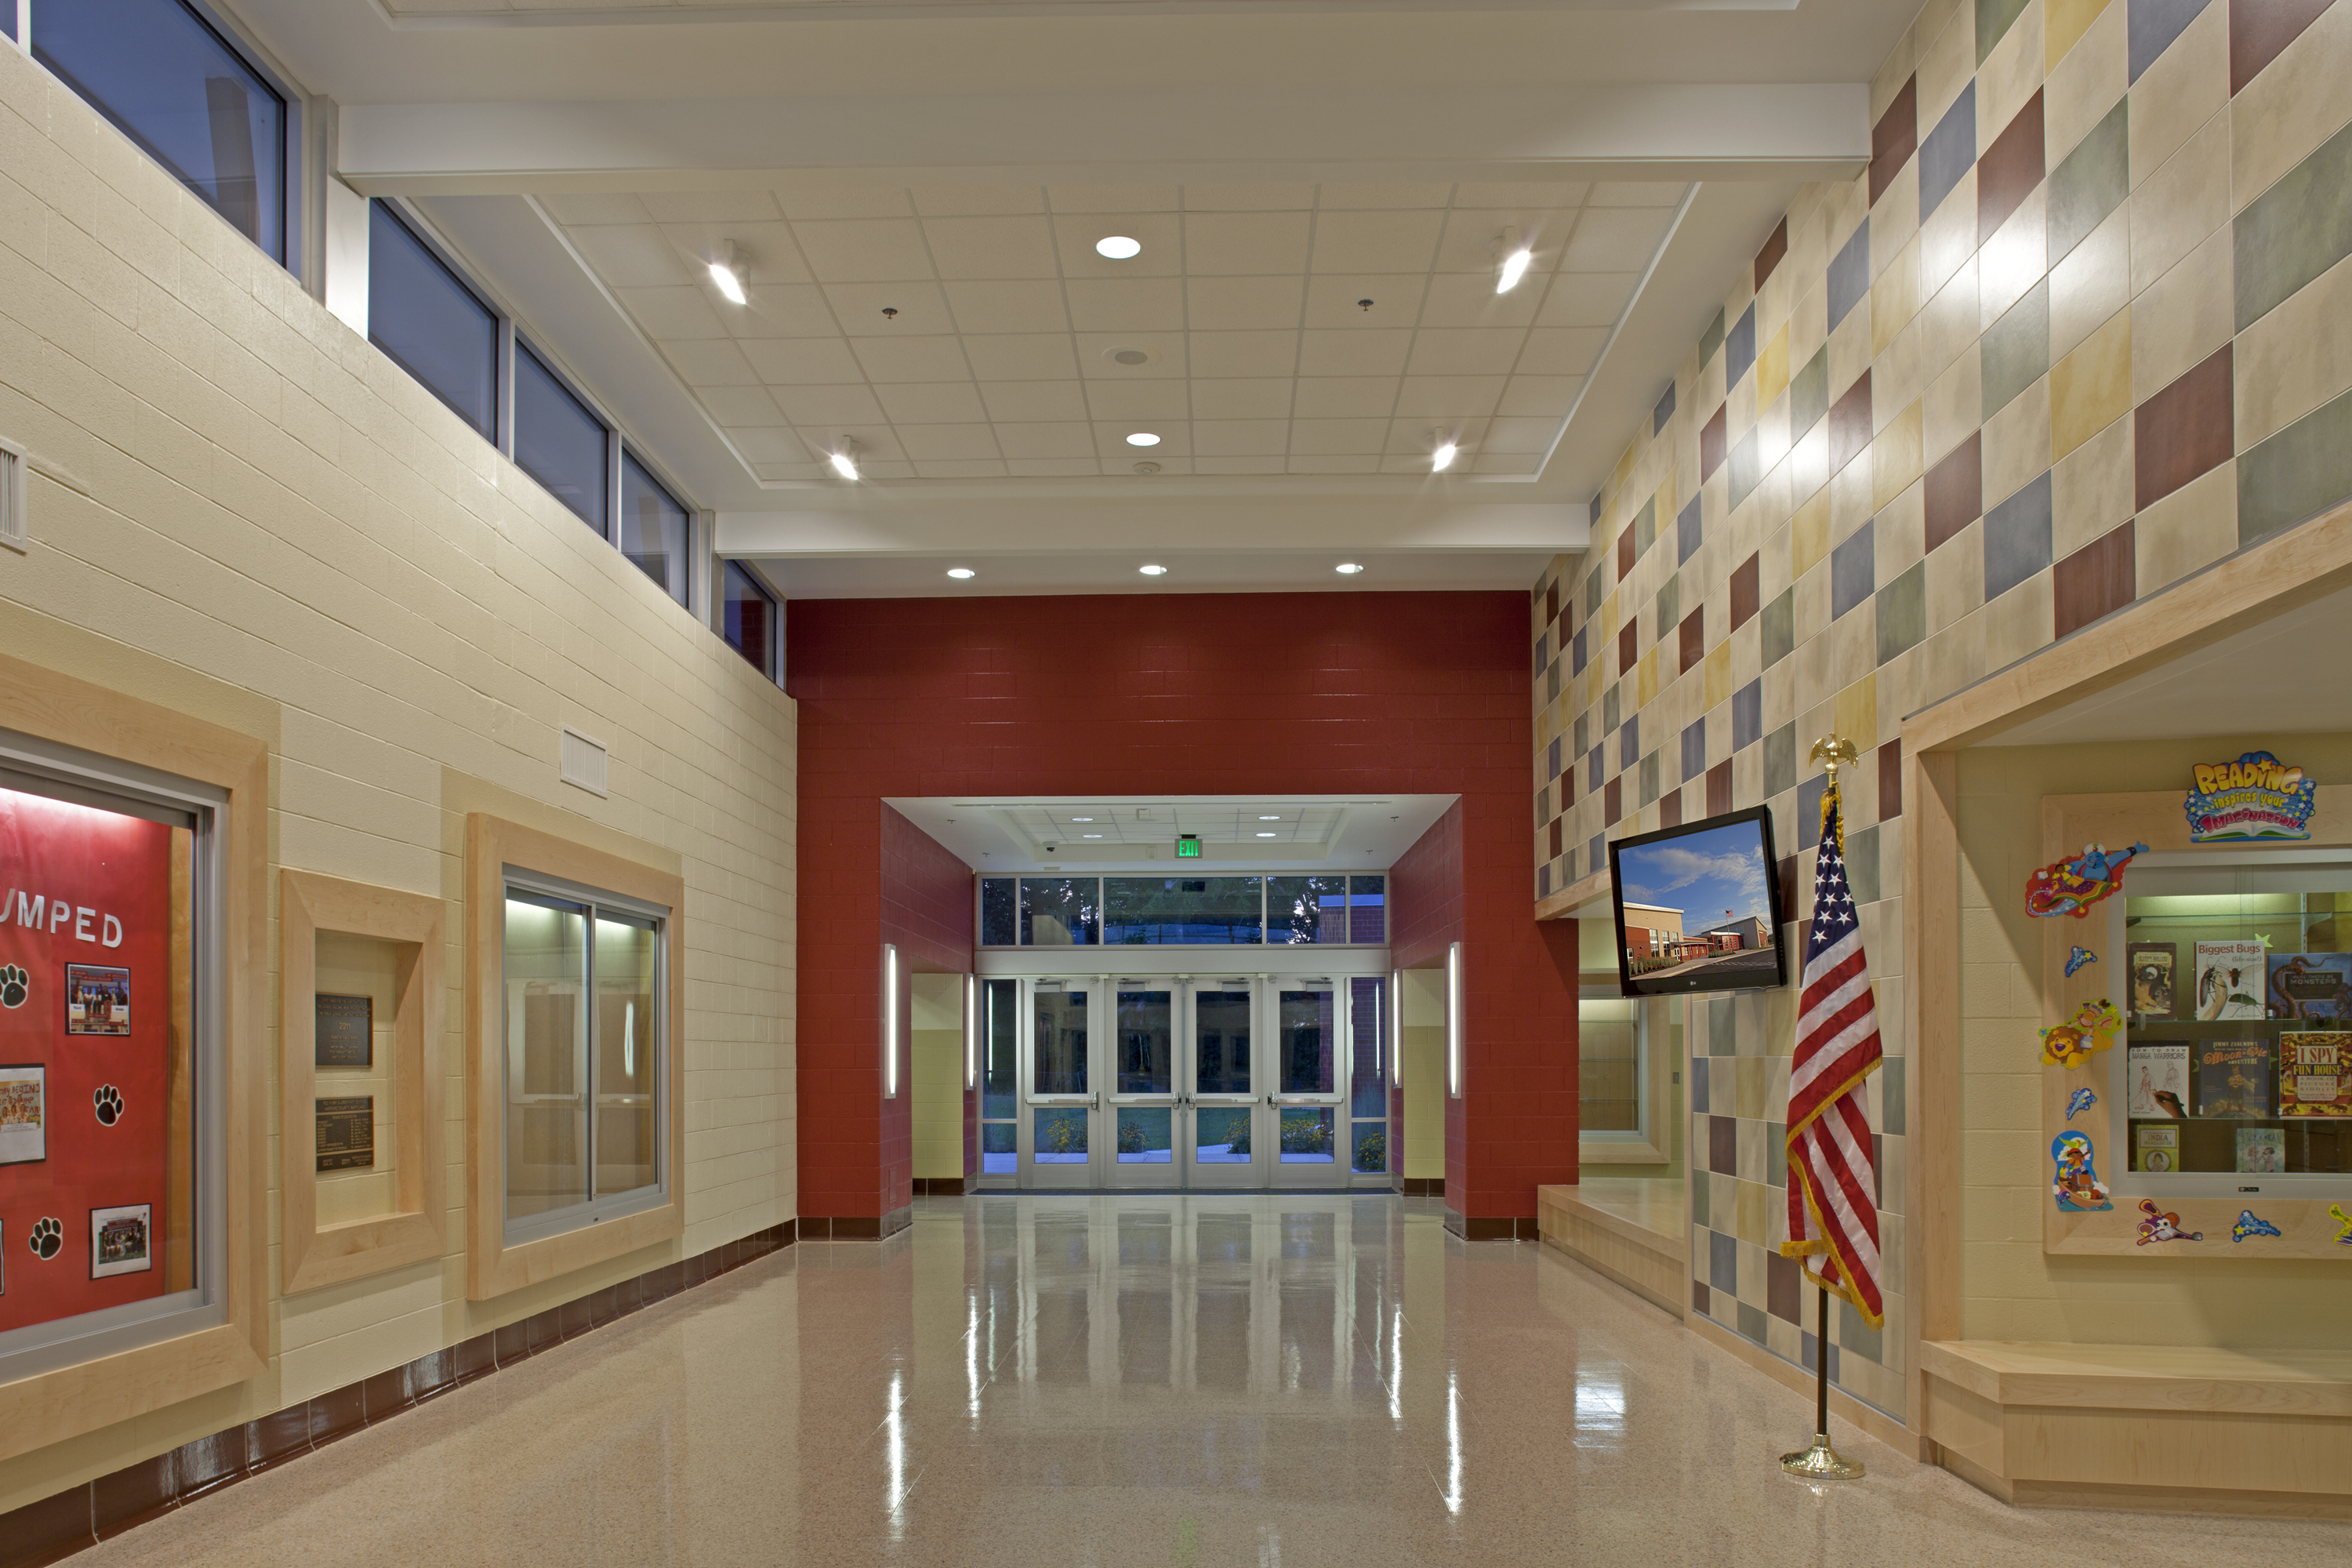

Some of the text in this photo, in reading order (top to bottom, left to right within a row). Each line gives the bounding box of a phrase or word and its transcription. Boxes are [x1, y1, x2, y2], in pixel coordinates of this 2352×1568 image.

[2192, 759, 2303, 795] READING
[2212, 791, 2285, 809] inspires your
[2200, 808, 2300, 833] IMAGINATION
[1179, 840, 1200, 856] EXIT
[2198, 943, 2260, 955] Biggest Bugs
[339, 1022, 351, 1030] 2011
[2300, 1047, 2334, 1063] I SPY
[2293, 1065, 2343, 1075] FUN HOUSE
